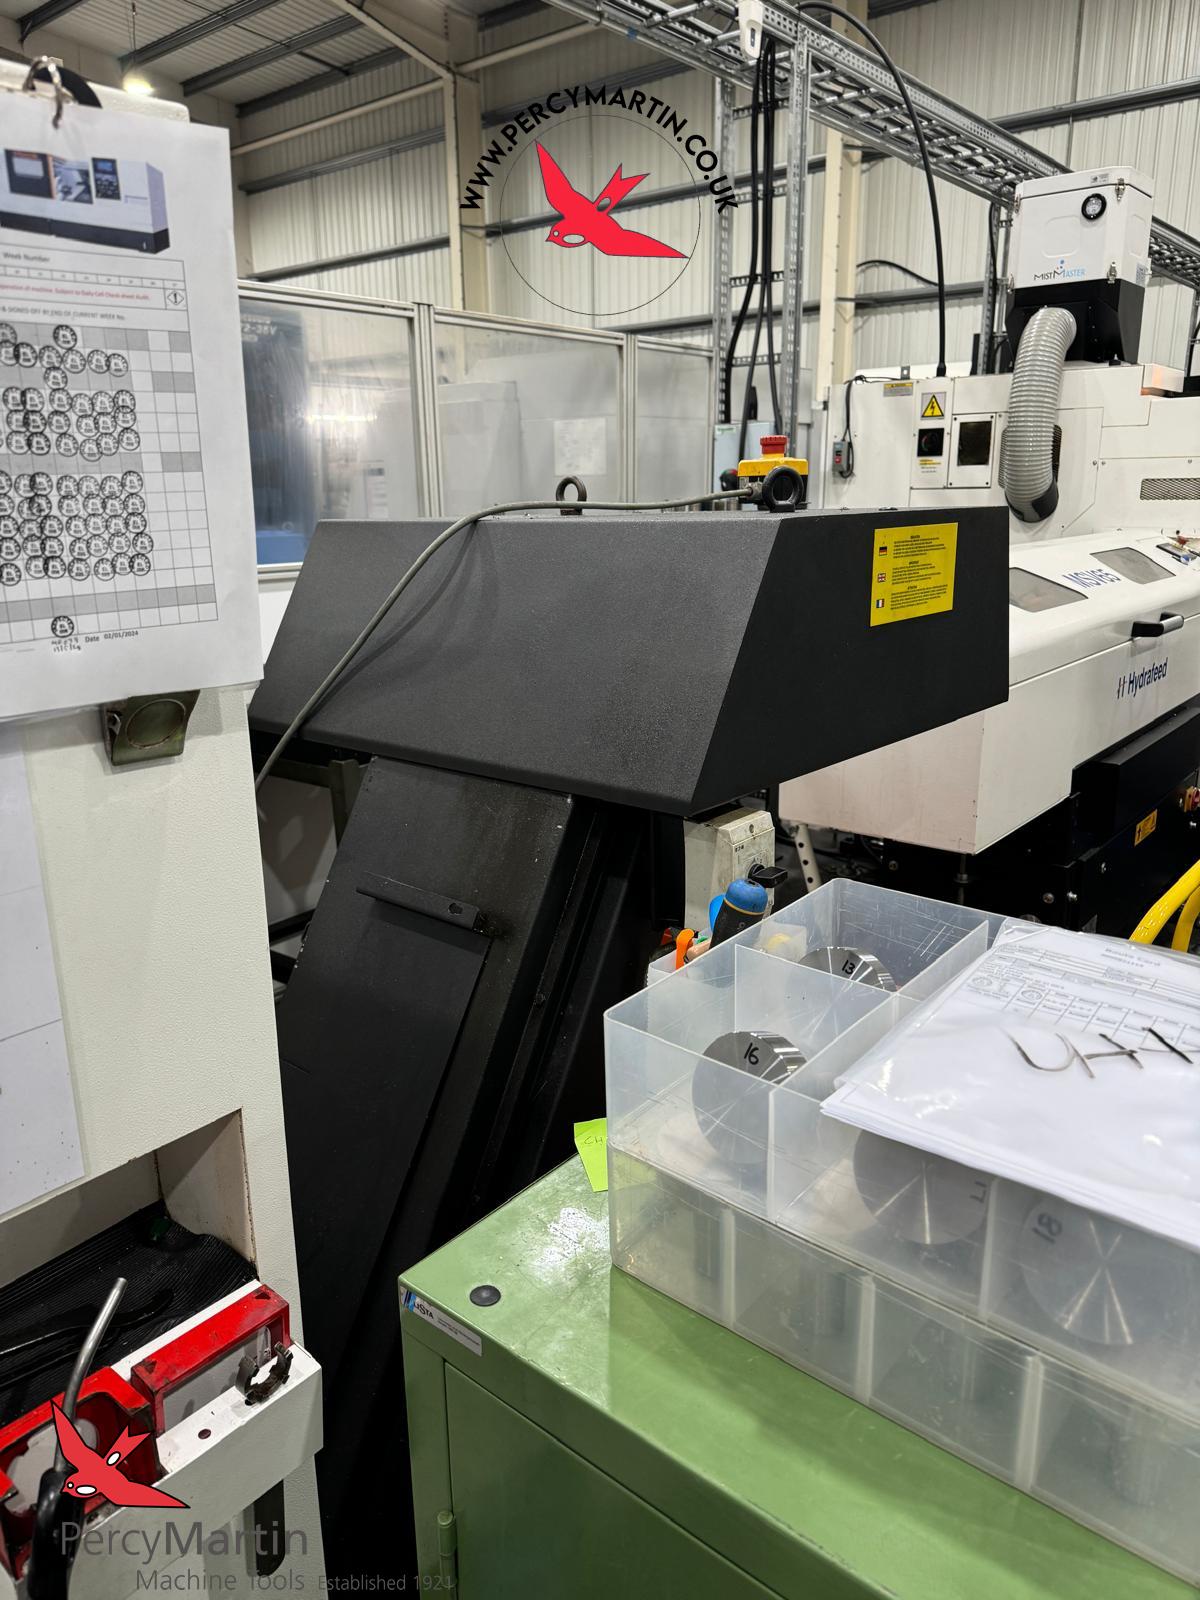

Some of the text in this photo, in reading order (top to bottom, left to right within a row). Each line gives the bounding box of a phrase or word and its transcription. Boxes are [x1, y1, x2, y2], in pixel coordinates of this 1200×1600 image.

[4, 252, 50, 262] Week Number
[85, 635, 100, 643] Date
[1127, 657, 1169, 696] Hydrafeed
[841, 959, 857, 975] 13
[743, 1042, 760, 1066] 16
